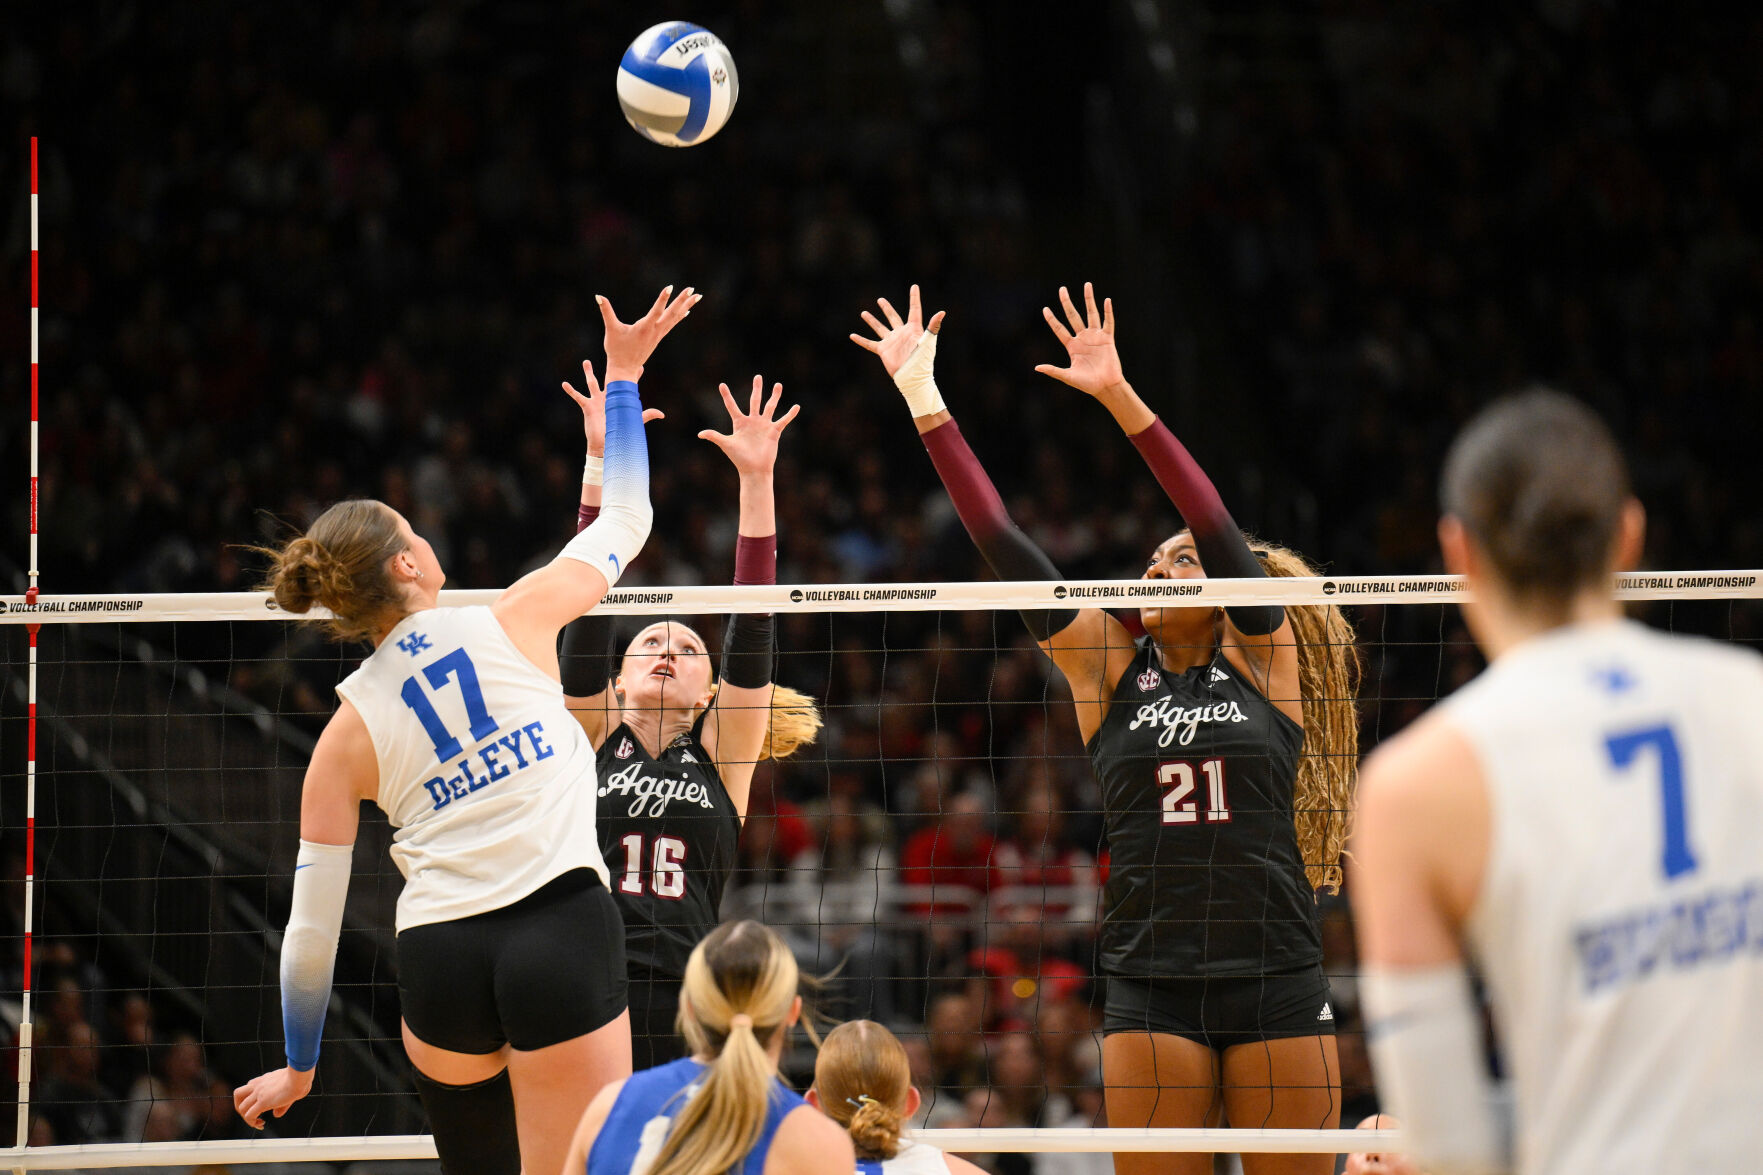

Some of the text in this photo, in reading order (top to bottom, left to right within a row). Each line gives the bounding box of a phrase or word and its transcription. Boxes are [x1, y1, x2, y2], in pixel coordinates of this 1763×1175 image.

[9, 601, 66, 613] VOLLEYBALL
[68, 600, 143, 612] CHAMPIONSHIP
[805, 590, 861, 601] VOLLEYBALL
[863, 589, 937, 600] CHAMPIONSHIP
[1069, 586, 1125, 598] VOLLEYBALL
[1128, 585, 1203, 596] CHAMPIONSHIP
[1338, 582, 1396, 593] VOLLEYBALL
[1615, 576, 1756, 589] VOLLEYBALL CHAMPIONSHIP
[400, 646, 500, 764] 17
[1129, 694, 1248, 748] Aggies
[597, 761, 714, 818] Aggies
[1154, 756, 1232, 826] 21
[1601, 720, 1698, 881] 7
[619, 831, 688, 900] 16
